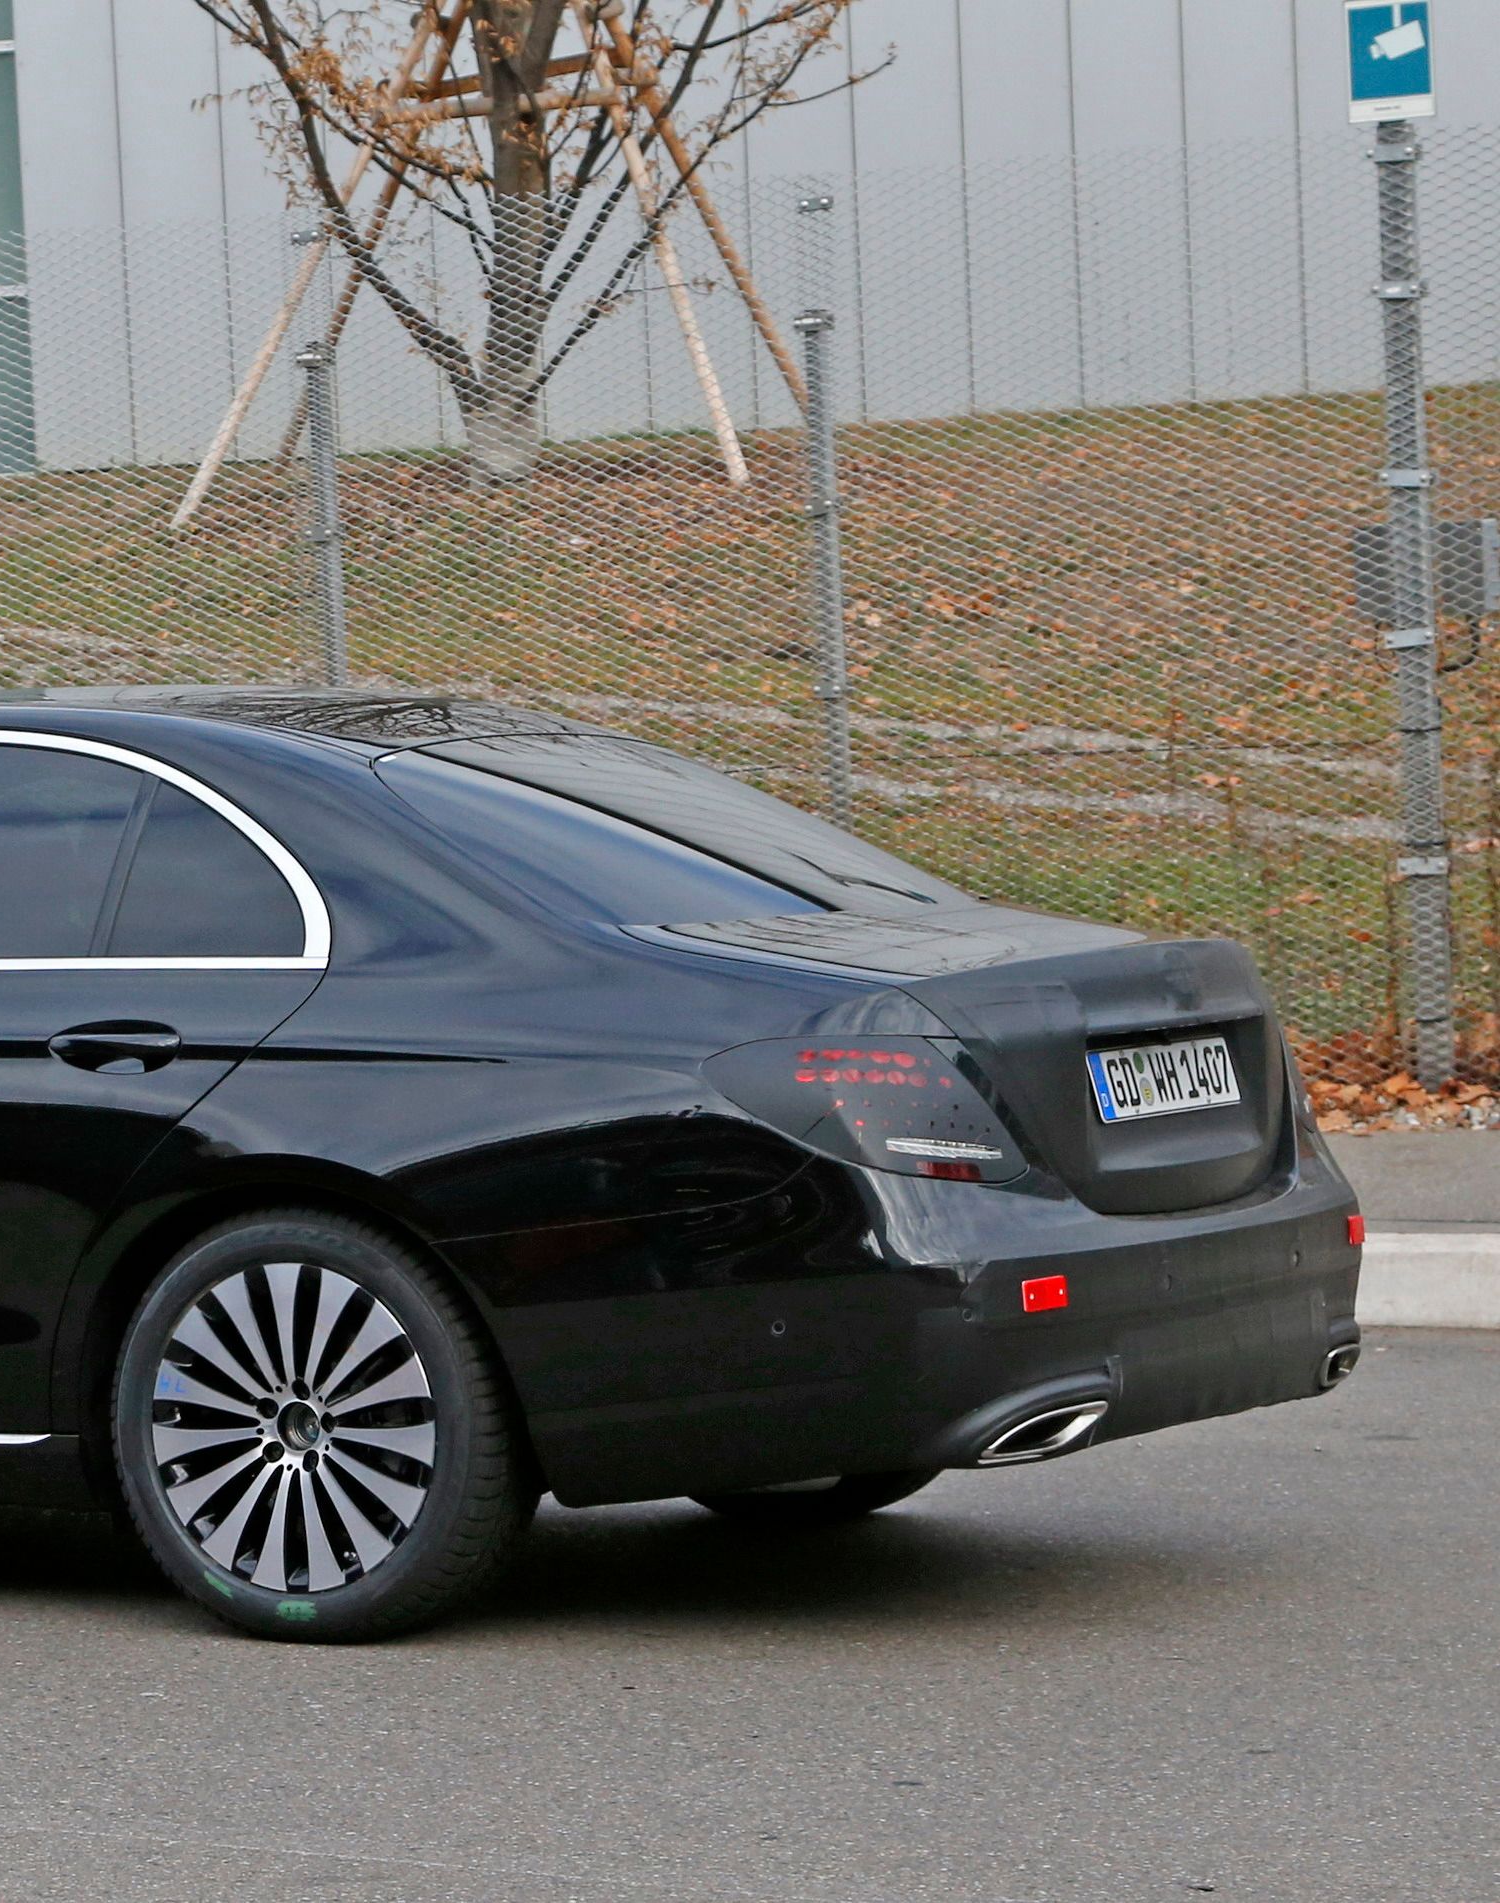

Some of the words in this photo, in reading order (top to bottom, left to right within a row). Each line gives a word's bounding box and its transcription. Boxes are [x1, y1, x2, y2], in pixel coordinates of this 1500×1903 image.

[1107, 1058, 1141, 1108] GD
[1147, 1051, 1184, 1103] WH
[1180, 1045, 1231, 1099] 1407
